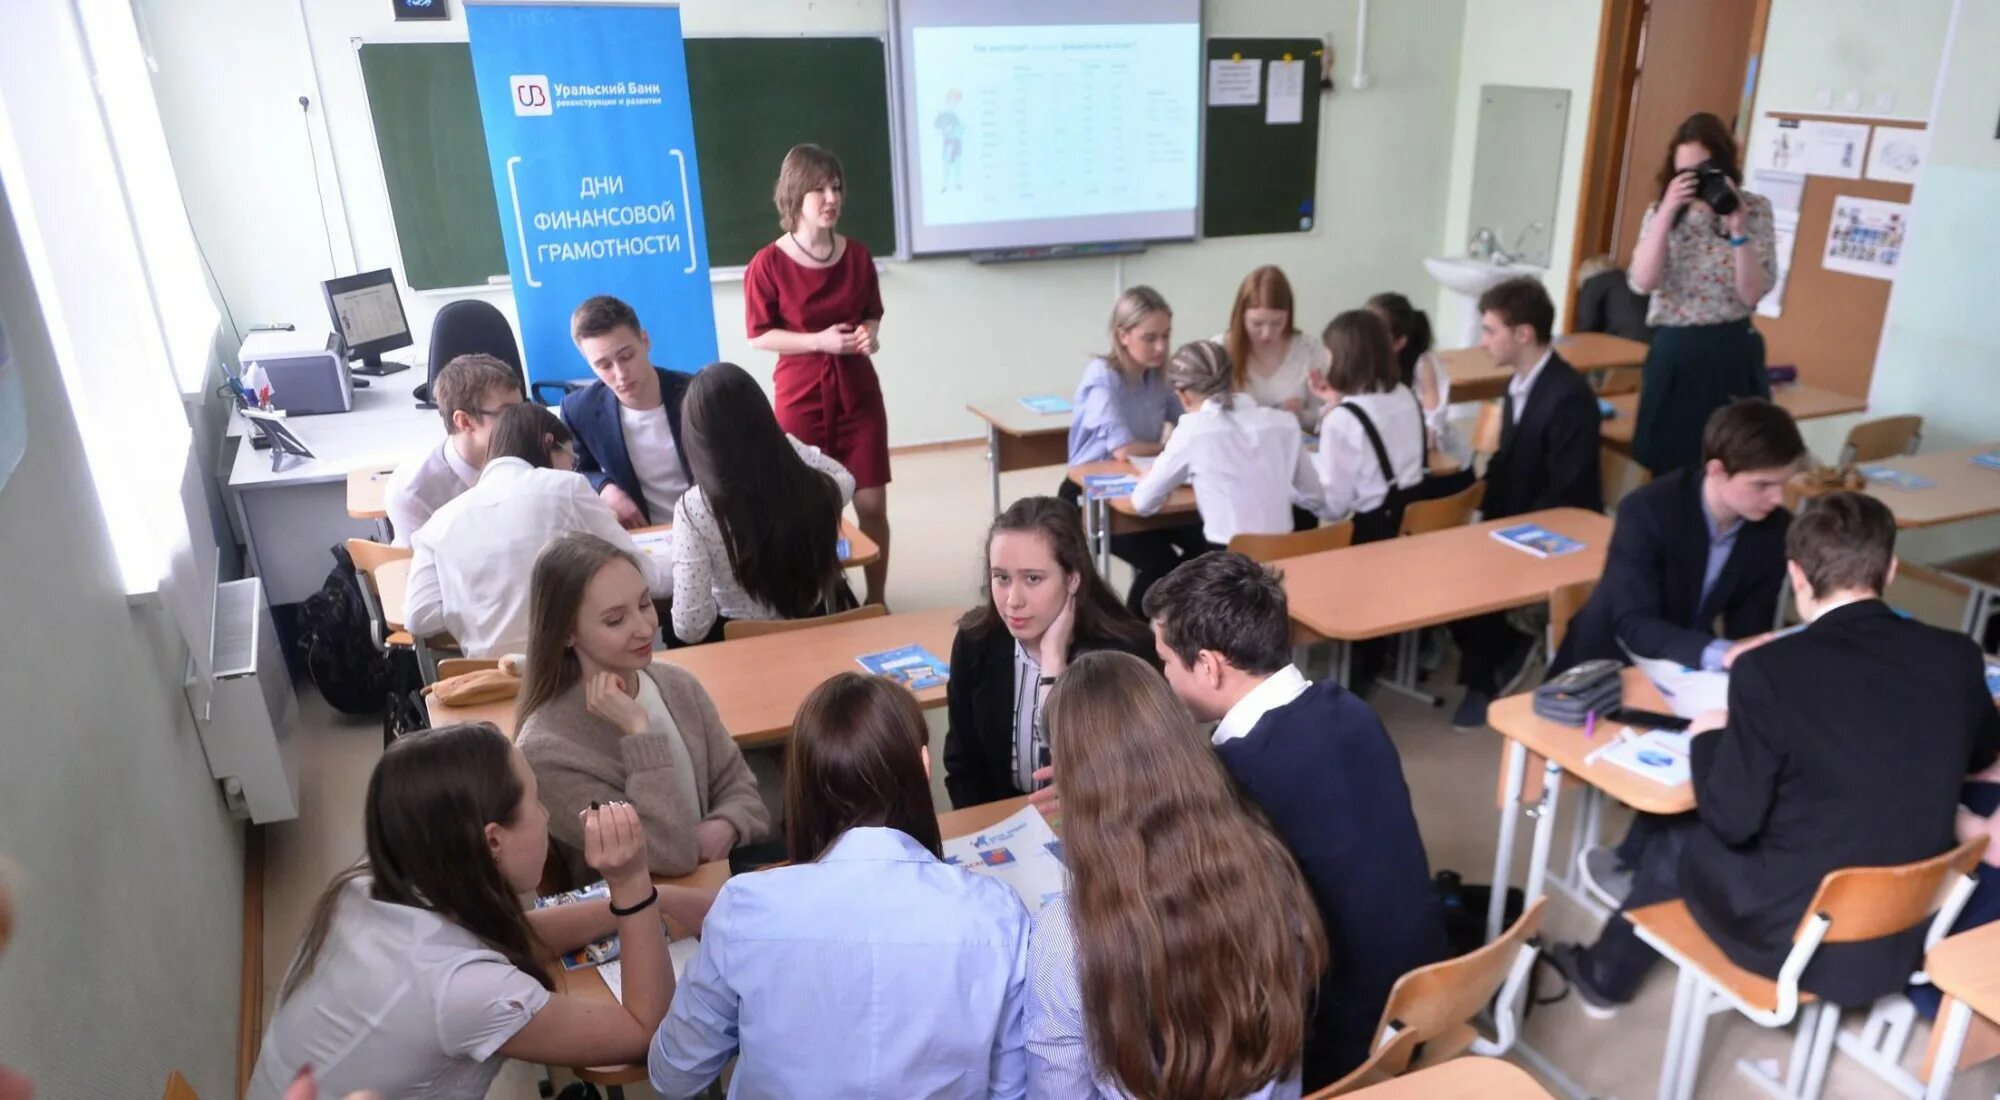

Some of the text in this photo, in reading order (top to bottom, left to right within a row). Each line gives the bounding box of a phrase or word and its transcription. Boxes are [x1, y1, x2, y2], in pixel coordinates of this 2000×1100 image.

[554, 82, 661, 97] Уральский Банк
[626, 97, 662, 107] развития
[580, 176, 623, 199] ДНИ
[534, 200, 675, 231] ФИНАНСОВОЙ
[538, 235, 680, 262] ГРАМОТНОСТИ
